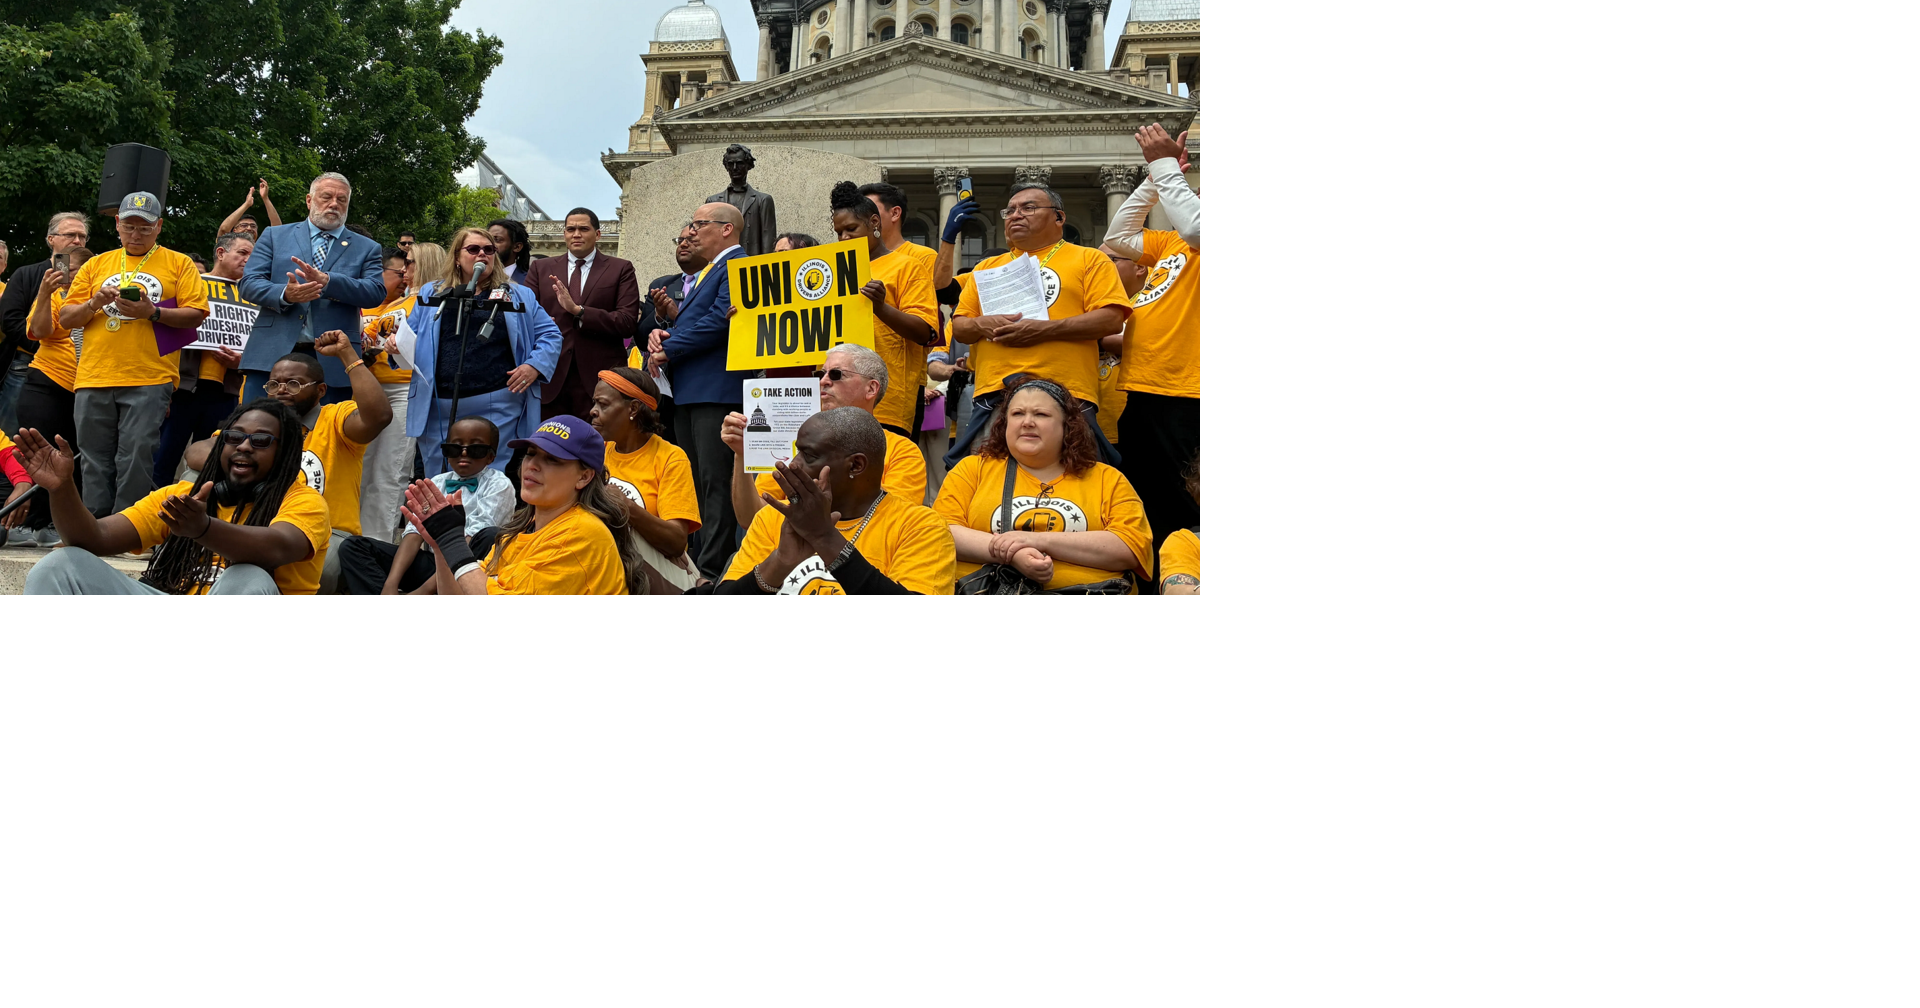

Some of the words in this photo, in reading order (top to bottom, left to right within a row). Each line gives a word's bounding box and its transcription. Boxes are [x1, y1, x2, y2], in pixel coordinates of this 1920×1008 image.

[801, 261, 826, 272] ILLINOIS
[201, 280, 228, 300] OTE
[813, 274, 831, 298] ALLIANCE
[214, 304, 256, 324] RIGHTS
[202, 319, 251, 335] RIDESHAR
[756, 304, 844, 357] NOW!
[198, 331, 242, 346] DRIVERS
[763, 387, 782, 397] TAKE
[784, 387, 812, 397] ACTION
